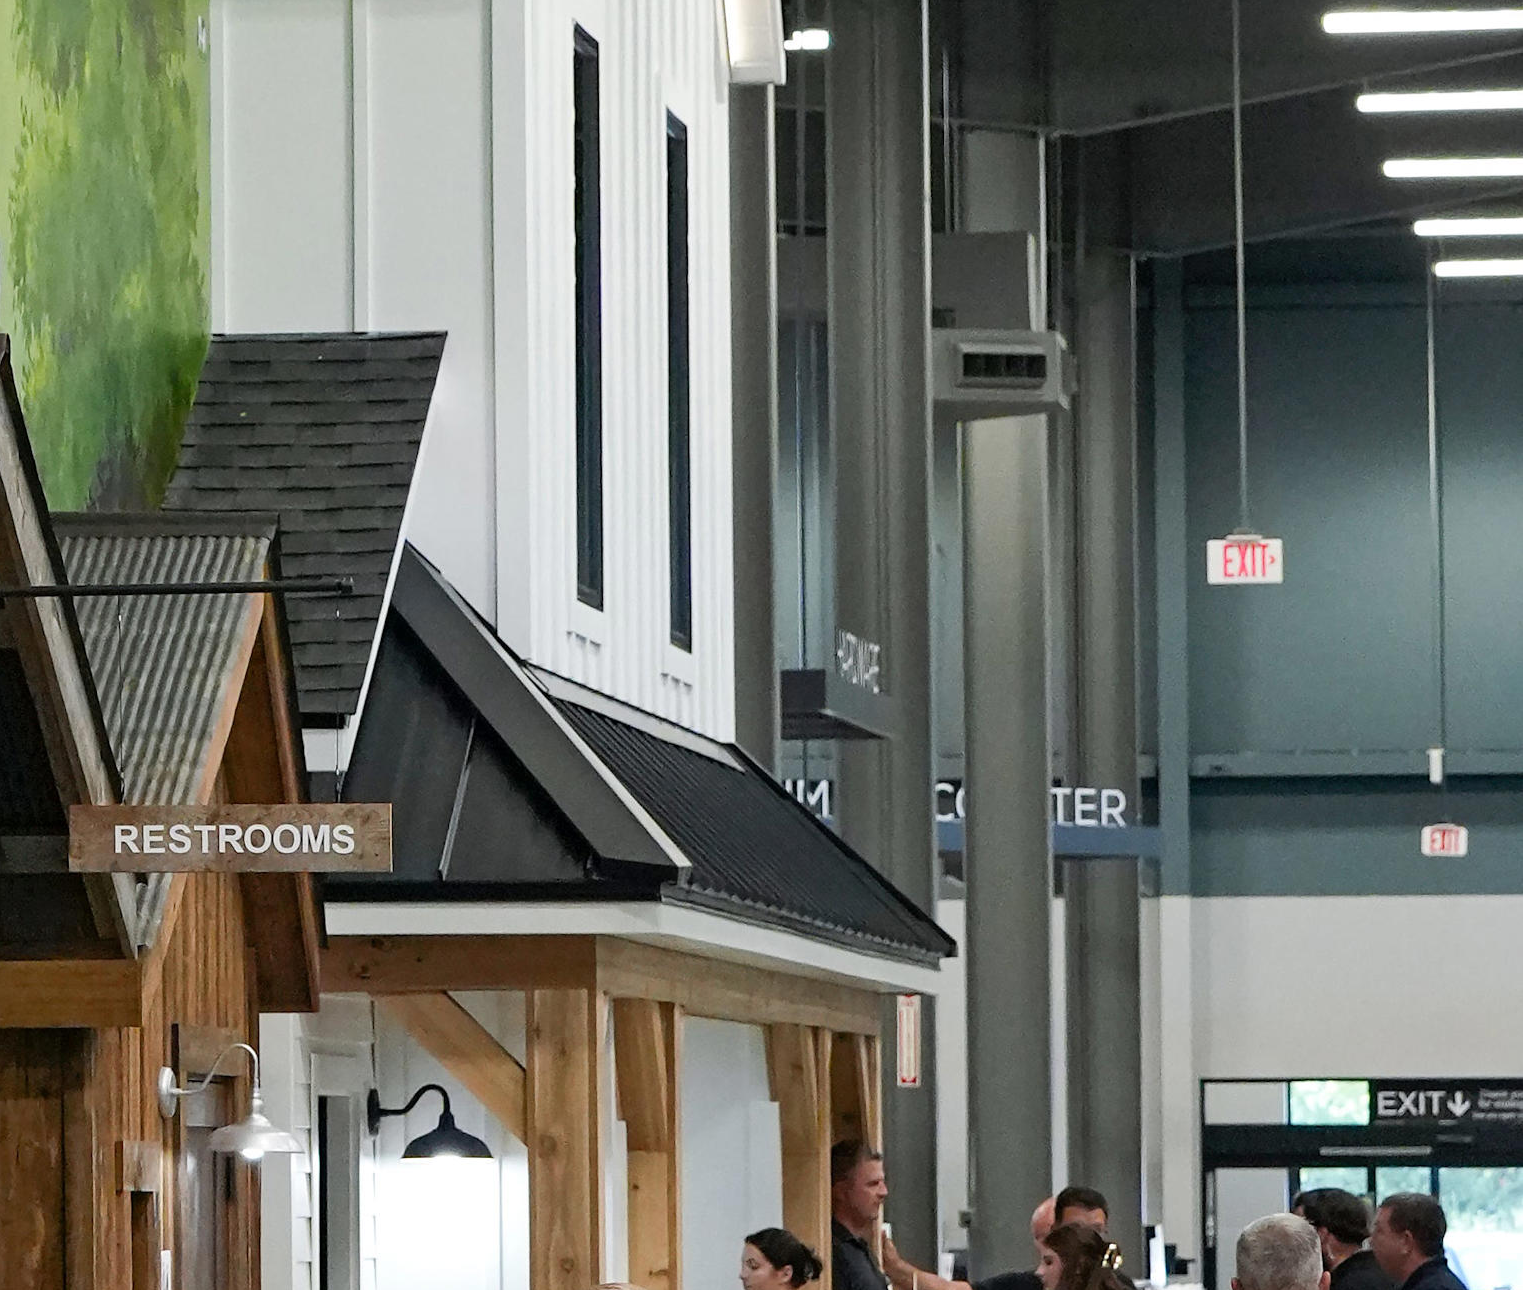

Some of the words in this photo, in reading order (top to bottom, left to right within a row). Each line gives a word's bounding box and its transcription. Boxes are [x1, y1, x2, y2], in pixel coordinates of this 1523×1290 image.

[1223, 543, 1268, 578] EXIT
[113, 823, 356, 855] RESTROOMS
[1430, 829, 1459, 854] EXIT
[1376, 1090, 1446, 1117] EXIT
